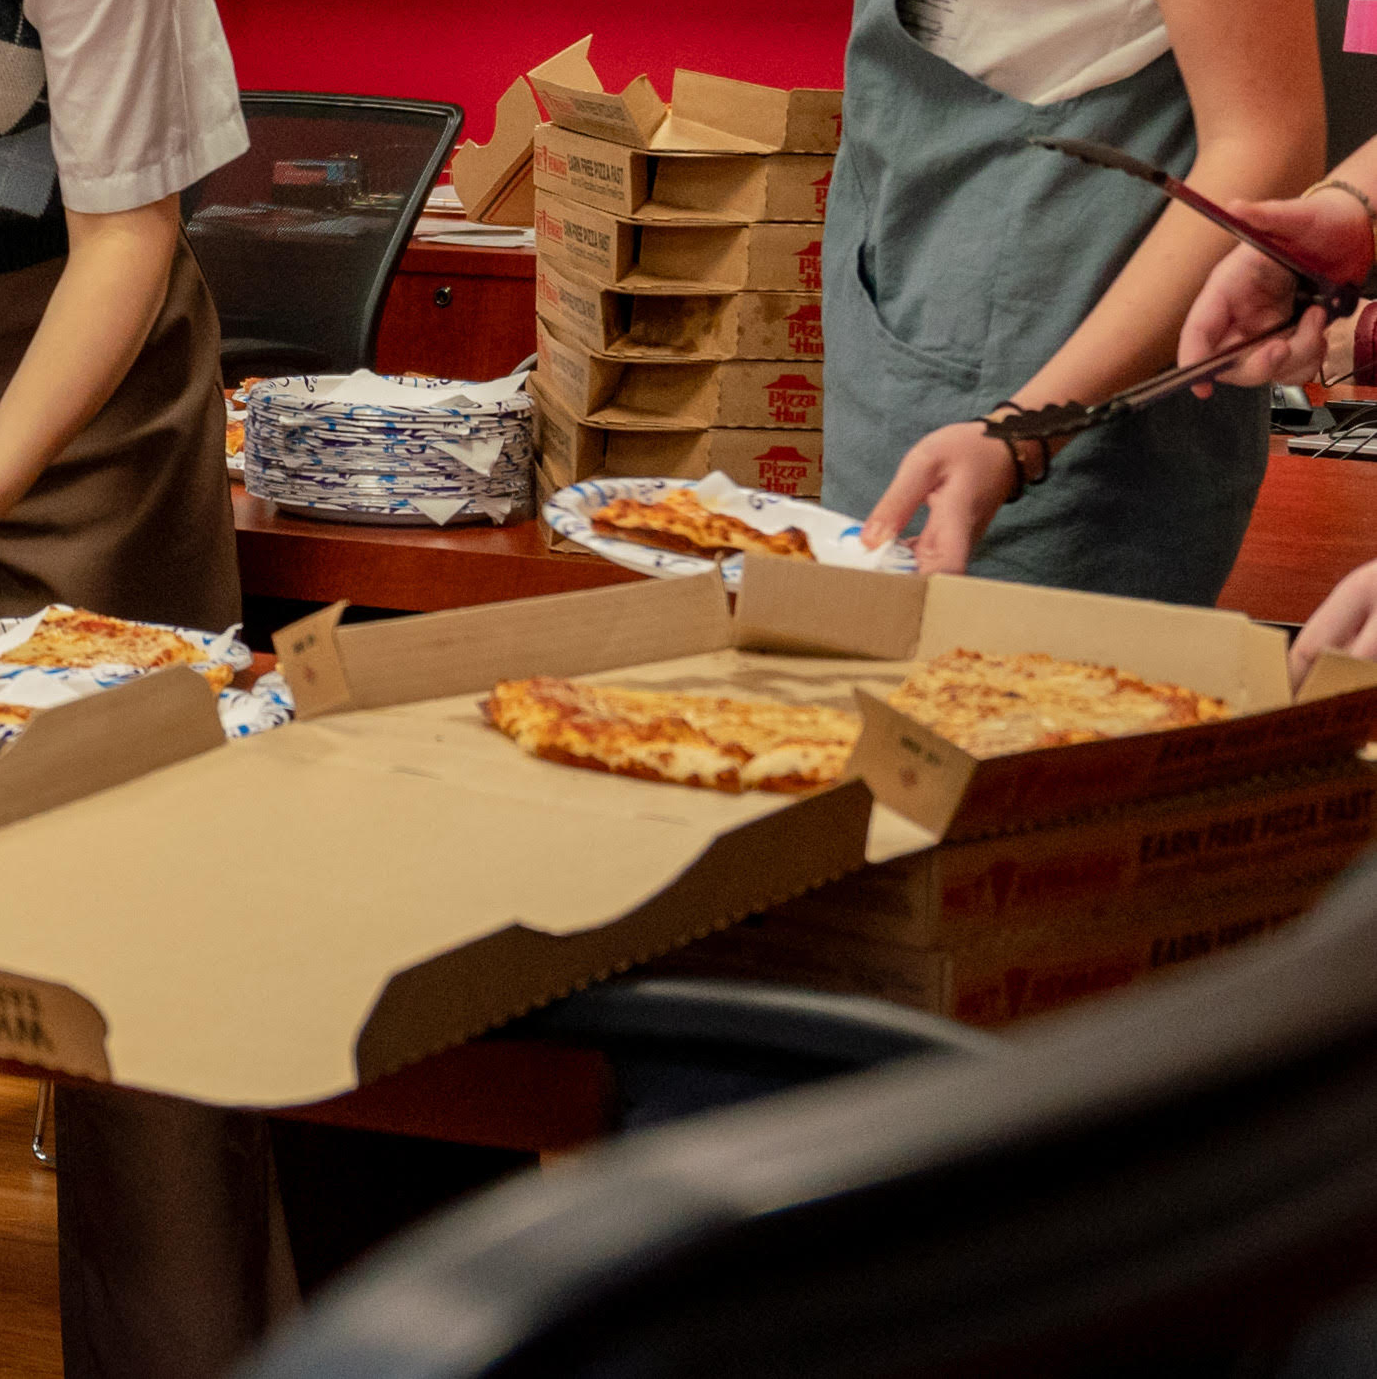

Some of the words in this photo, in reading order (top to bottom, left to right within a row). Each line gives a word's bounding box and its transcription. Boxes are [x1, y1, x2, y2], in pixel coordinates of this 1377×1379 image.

[768, 389, 817, 409] Pizza
[768, 406, 808, 424] Hut
[758, 460, 808, 480] Pizza
[758, 477, 799, 495] Hut
